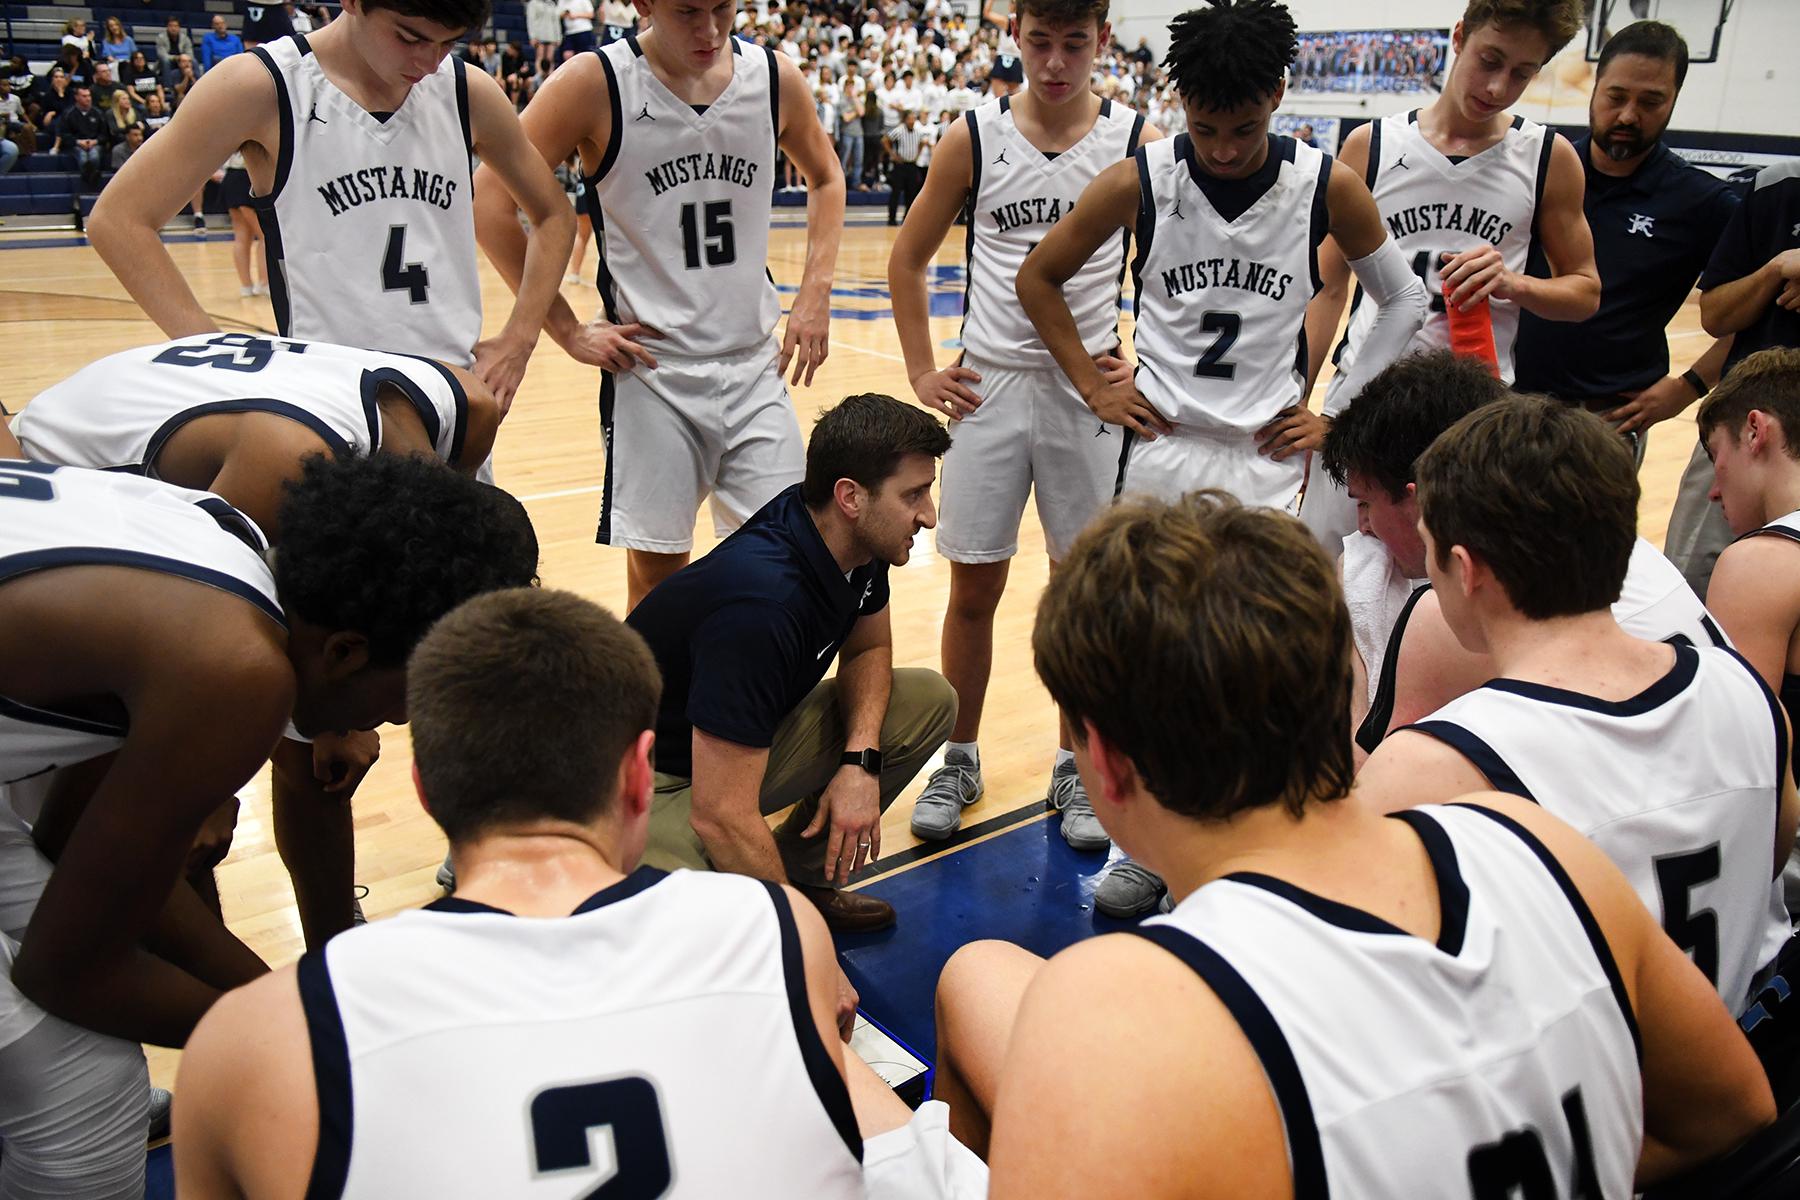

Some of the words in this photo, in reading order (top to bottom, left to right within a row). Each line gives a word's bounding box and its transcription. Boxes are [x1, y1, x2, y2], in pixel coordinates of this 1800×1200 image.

[317, 166, 457, 216] MUSTANGS
[645, 152, 758, 196] MUSTANGS
[679, 199, 737, 270] 15
[990, 197, 1074, 233] MUSTA
[1386, 203, 1513, 246] MUSTANGS
[380, 223, 430, 305] 4
[1161, 258, 1294, 301] MUSTANGS
[1193, 310, 1243, 381] 2
